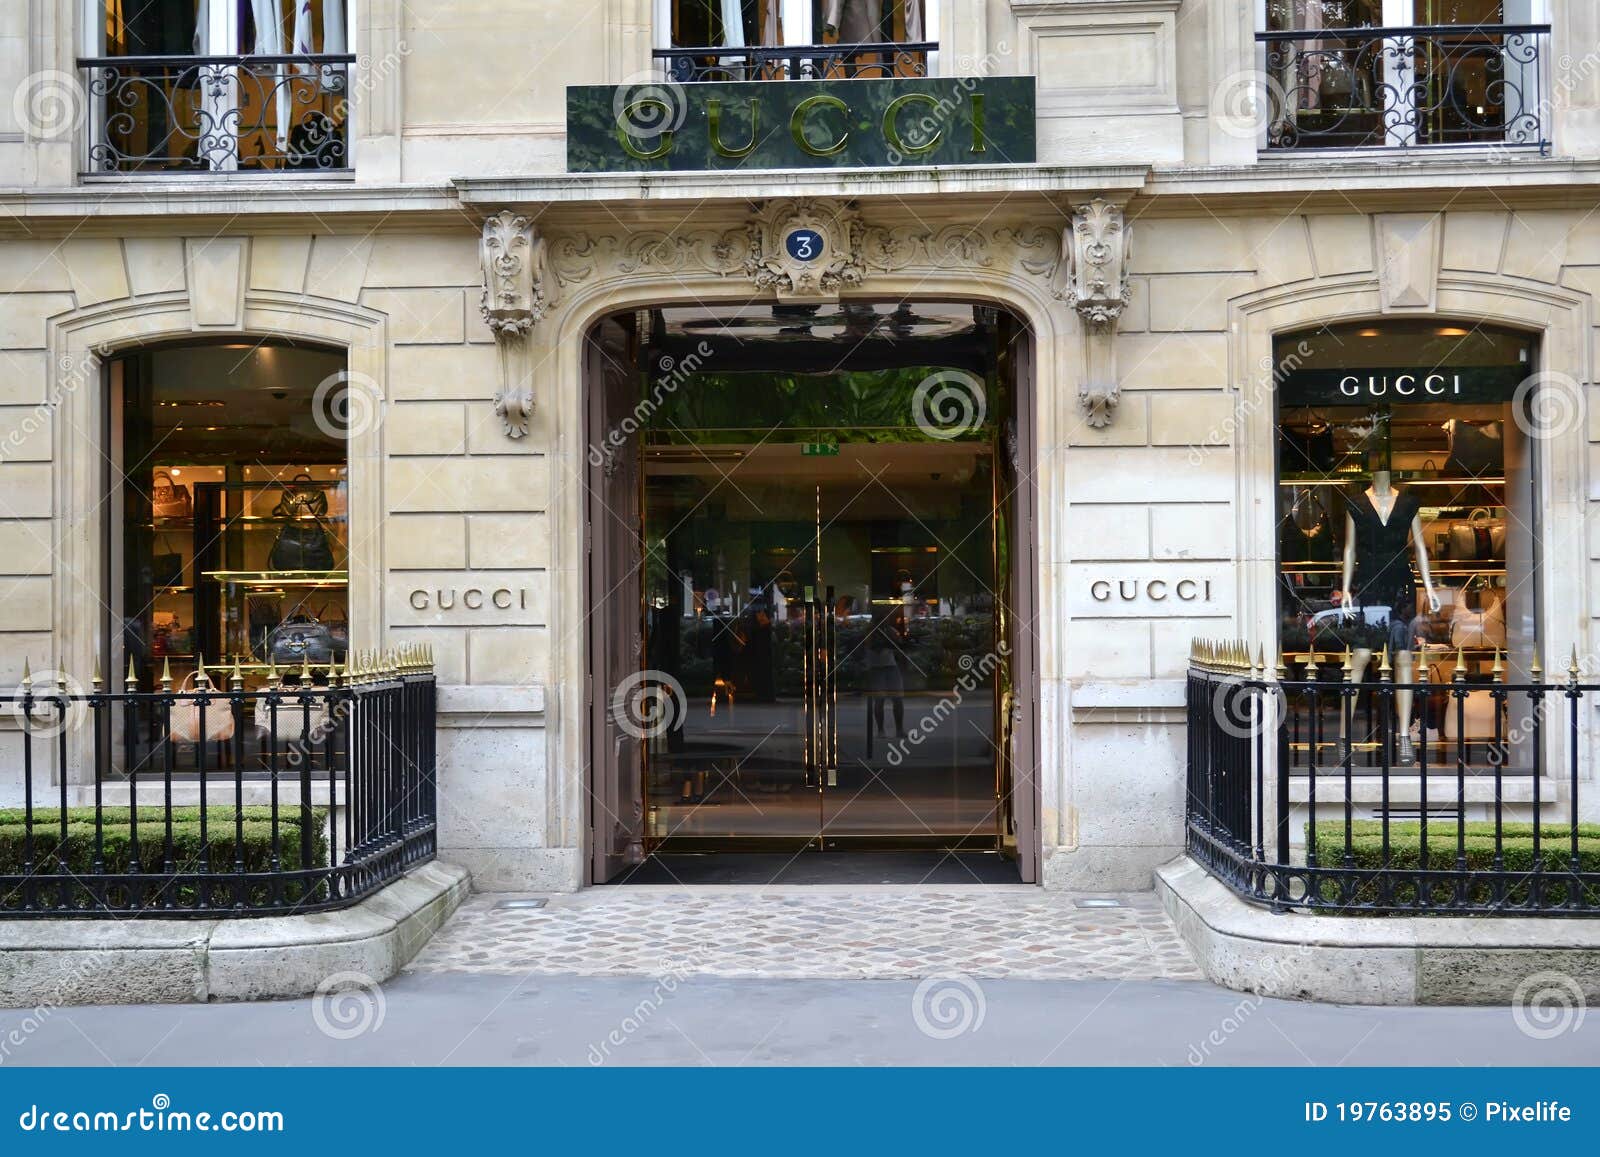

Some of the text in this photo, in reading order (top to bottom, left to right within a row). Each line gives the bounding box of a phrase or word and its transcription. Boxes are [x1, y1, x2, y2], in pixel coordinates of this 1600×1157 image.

[615, 93, 986, 160] GUCCI
[796, 236, 812, 258] 3
[1339, 374, 1460, 396] GUCCI
[409, 588, 526, 610] GUCCI
[1091, 579, 1211, 602] GUCCI
